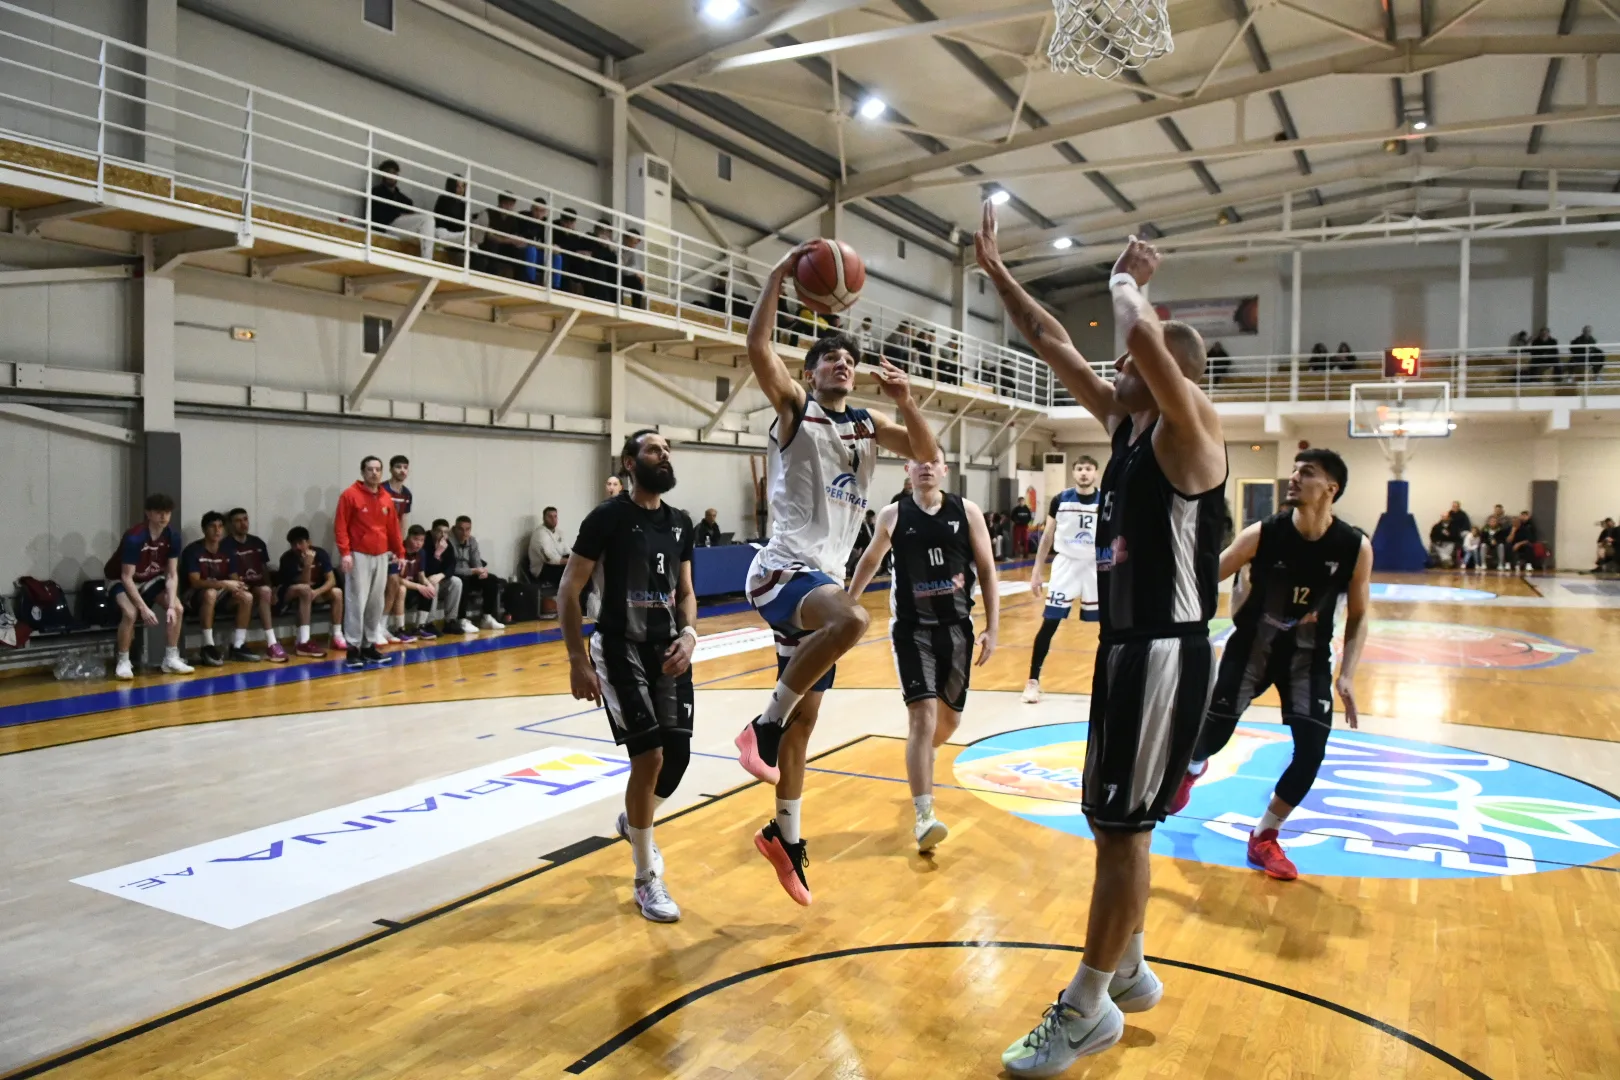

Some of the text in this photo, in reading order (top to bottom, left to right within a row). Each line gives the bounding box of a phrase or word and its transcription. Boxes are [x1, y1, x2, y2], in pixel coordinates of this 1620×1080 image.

[1078, 514, 1093, 529] 12
[656, 552, 665, 575] 3
[927, 547, 944, 566] 10
[1050, 590, 1066, 606] 12
[1292, 586, 1310, 604] 12
